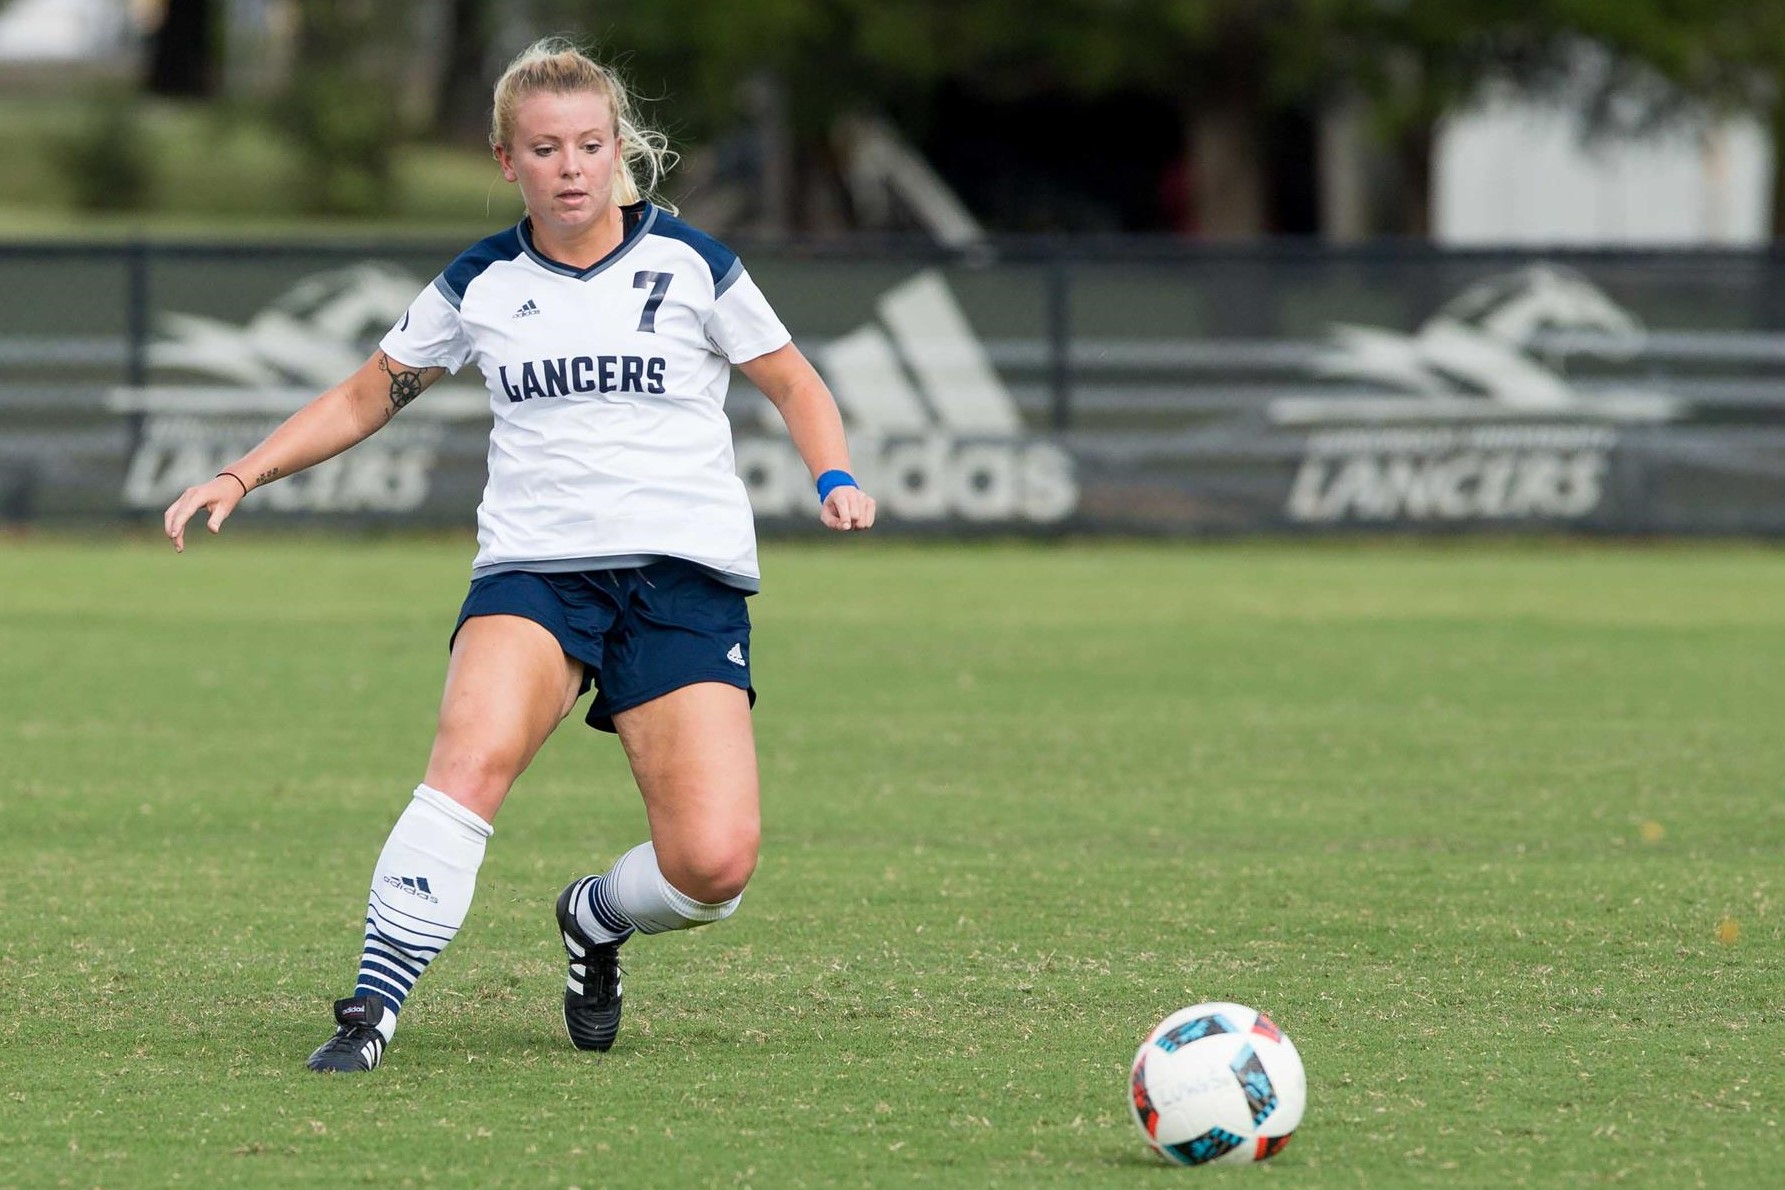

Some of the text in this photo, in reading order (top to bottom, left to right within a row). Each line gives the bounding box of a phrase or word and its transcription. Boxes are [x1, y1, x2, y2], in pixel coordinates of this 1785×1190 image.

[514, 310, 540, 318] adidas
[632, 270, 675, 333] 7
[499, 355, 667, 402] LANCERS
[383, 875, 439, 904] adidas
